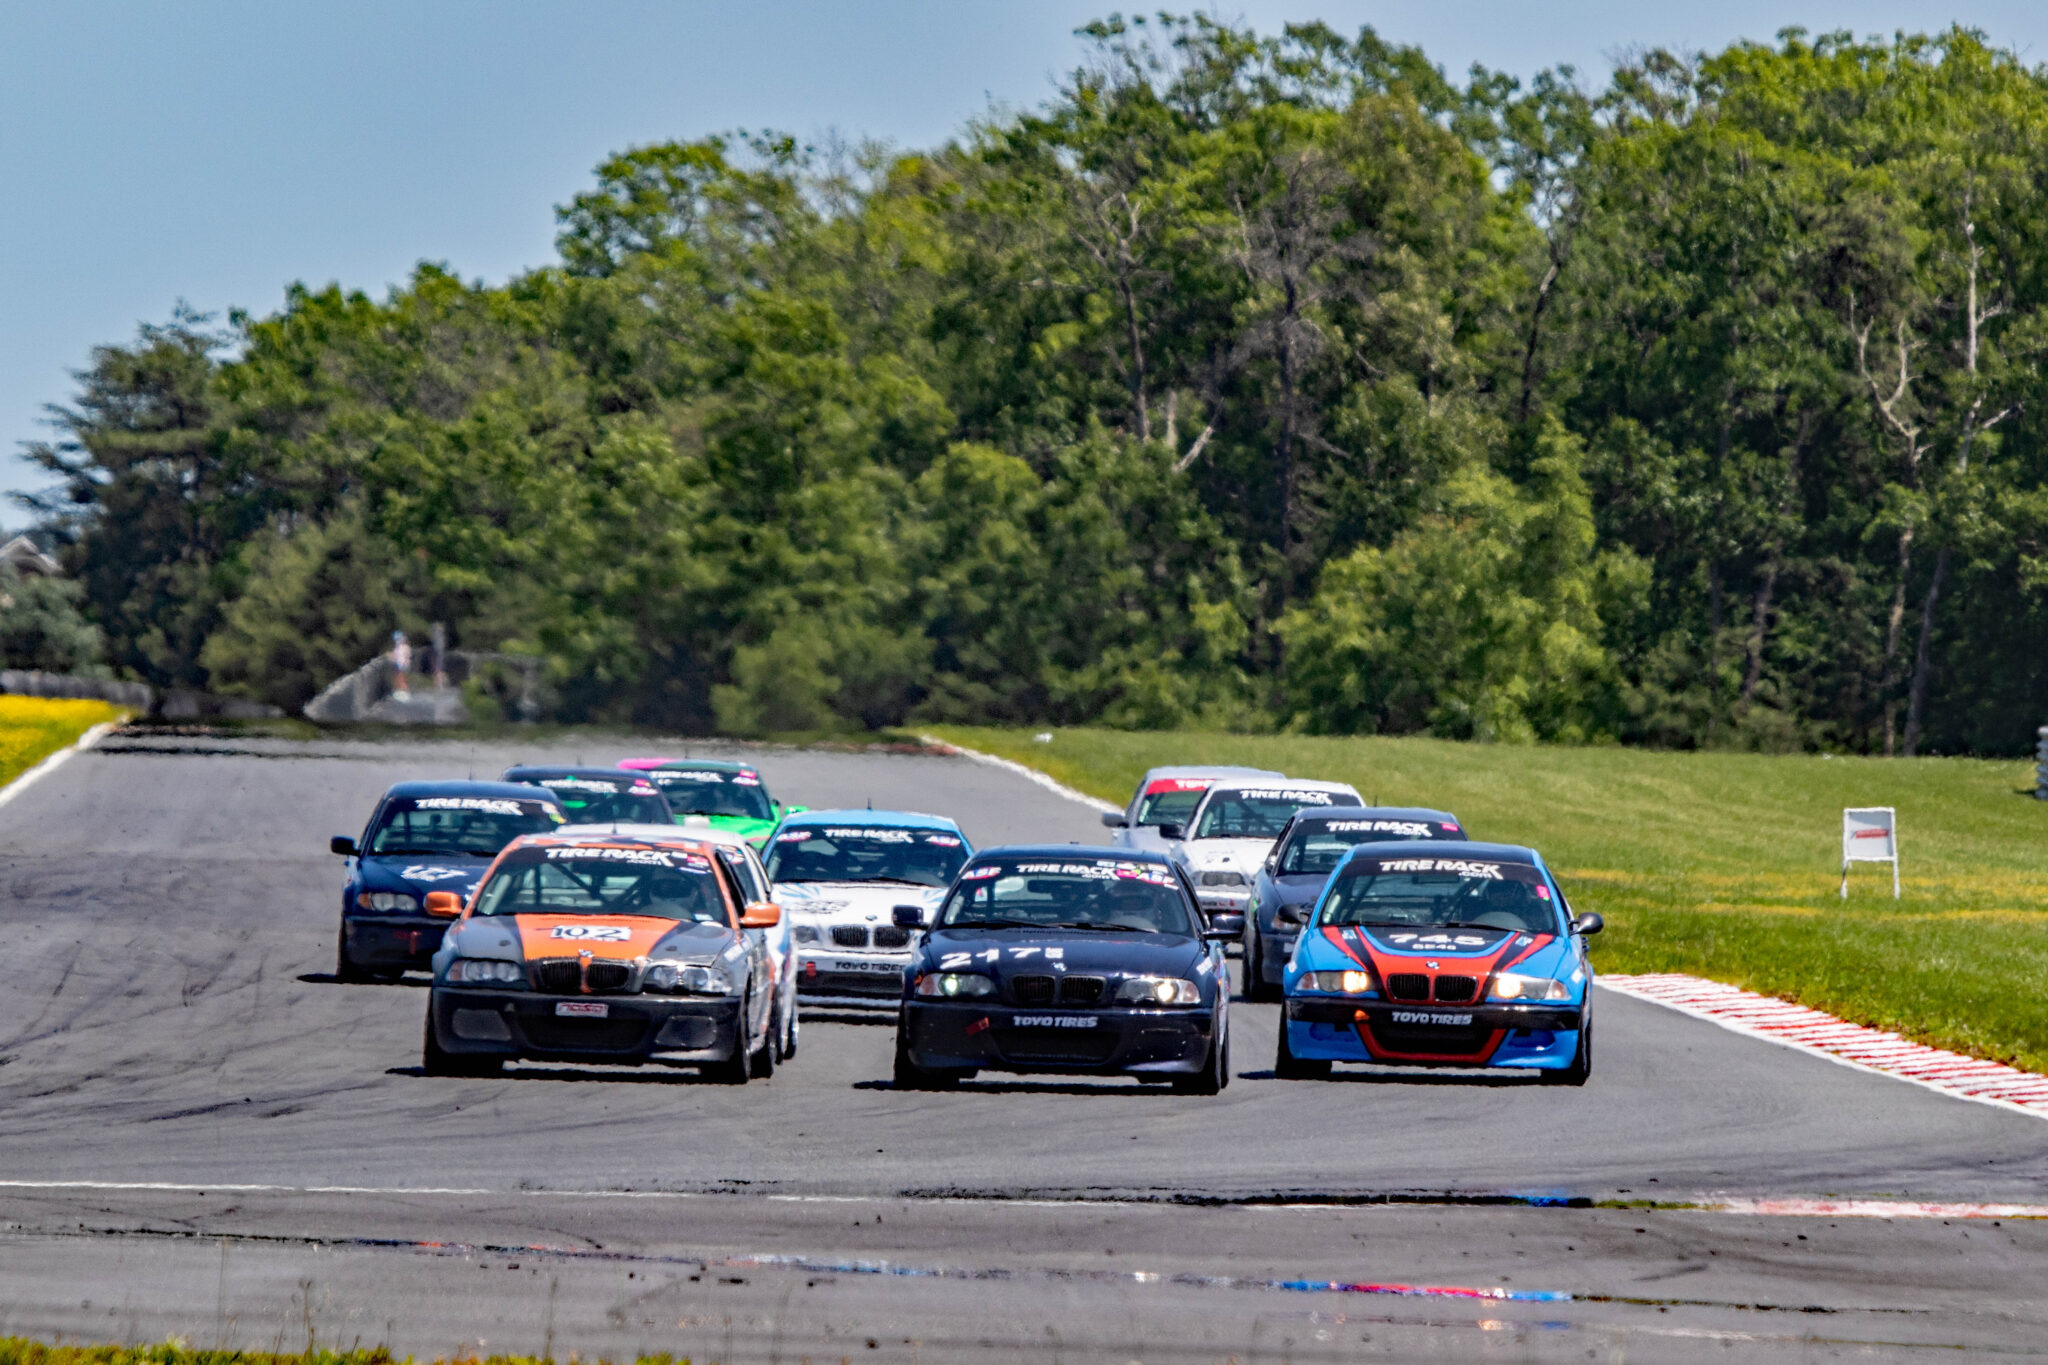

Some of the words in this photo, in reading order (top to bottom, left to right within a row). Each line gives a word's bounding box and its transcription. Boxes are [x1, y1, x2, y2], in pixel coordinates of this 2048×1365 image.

[1240, 789, 1280, 799] TIRE
[1282, 790, 1333, 805] RACK
[415, 798, 460, 809] TIRE
[461, 799, 524, 816] RACK
[1326, 821, 1373, 832] TIRE
[1373, 822, 1432, 837] RACK
[545, 848, 602, 859] TIRE
[601, 849, 675, 867] RACK
[1016, 864, 1061, 873] TIRE
[1061, 864, 1120, 880] RACK
[1379, 860, 1435, 872] TIRE
[1434, 860, 1504, 880] RACK
[555, 926, 623, 939] 102
[1389, 933, 1486, 945] 745
[835, 961, 868, 971] TOYO
[1013, 1016, 1053, 1026] TOYO
[1054, 1016, 1098, 1028] TIRES
[1392, 1011, 1430, 1023] TOYO
[1430, 1013, 1473, 1025] TIRES
